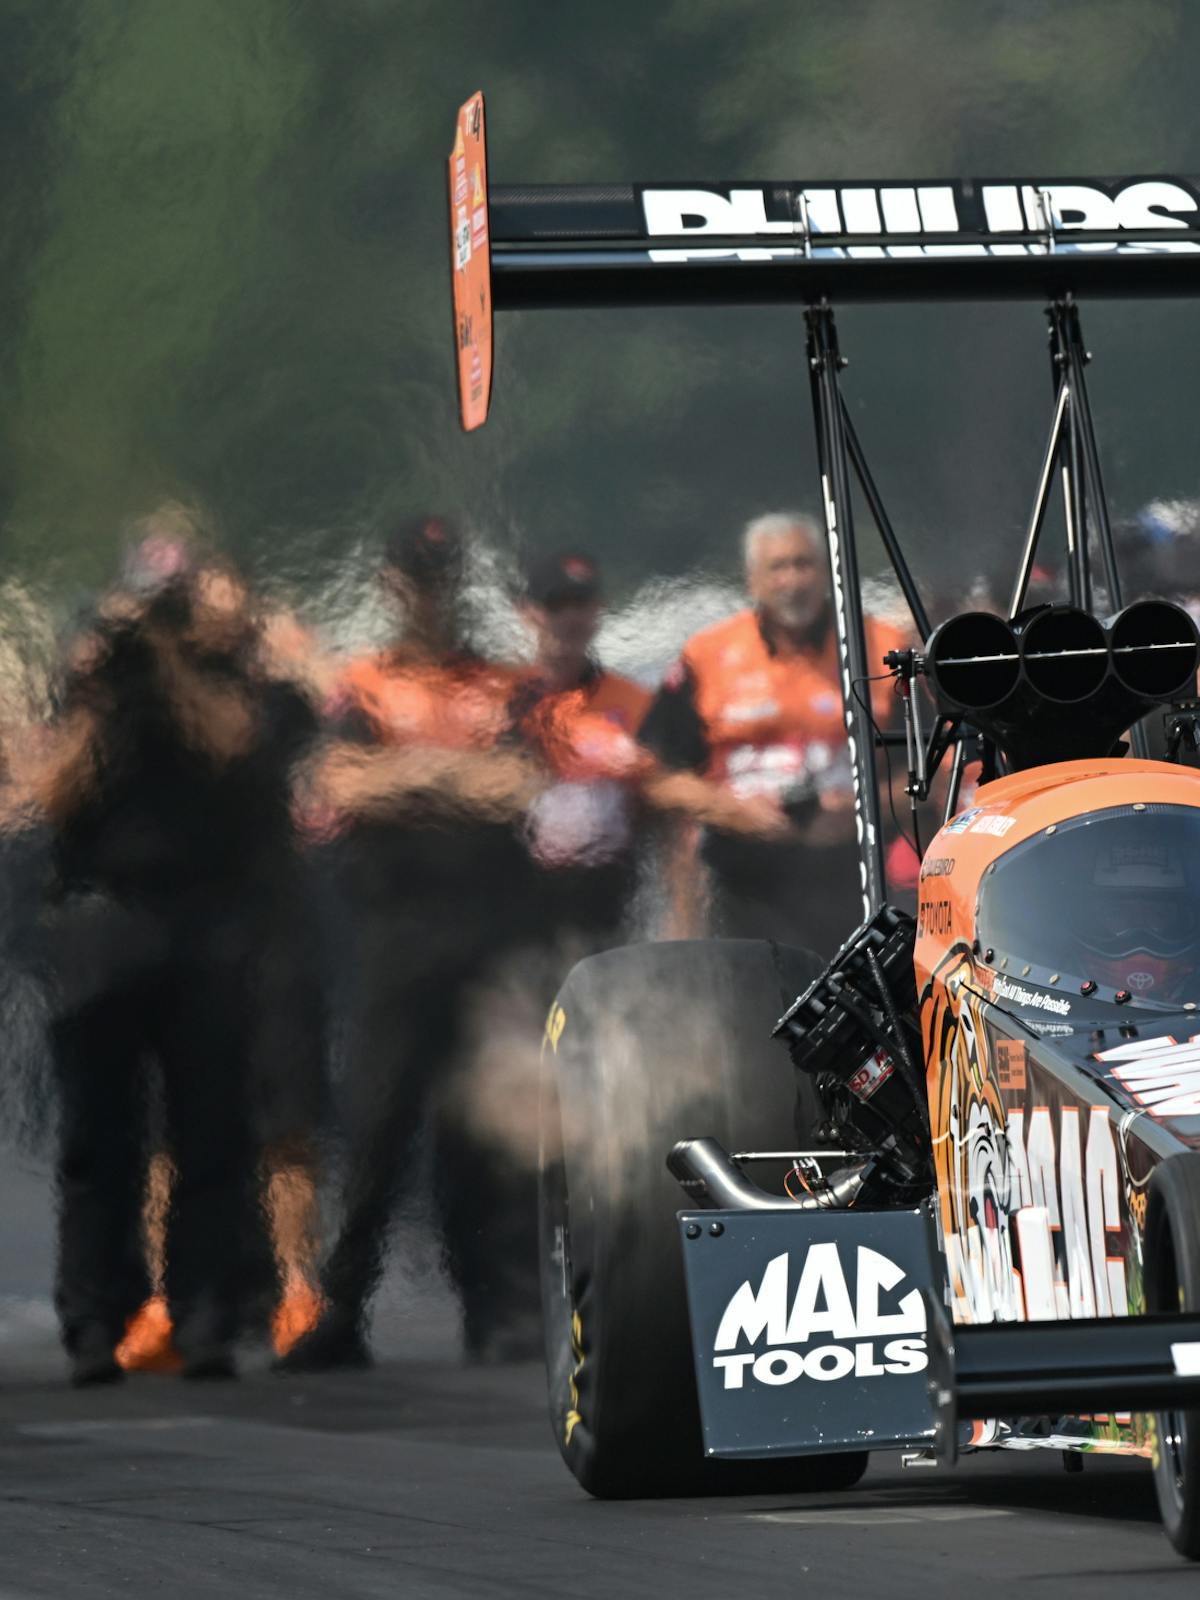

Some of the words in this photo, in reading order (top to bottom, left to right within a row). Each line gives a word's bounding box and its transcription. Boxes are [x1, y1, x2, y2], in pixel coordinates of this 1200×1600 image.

[926, 900, 953, 934] TOYOTA
[714, 1243, 927, 1351] MAC
[713, 1339, 929, 1390] TOOLS
